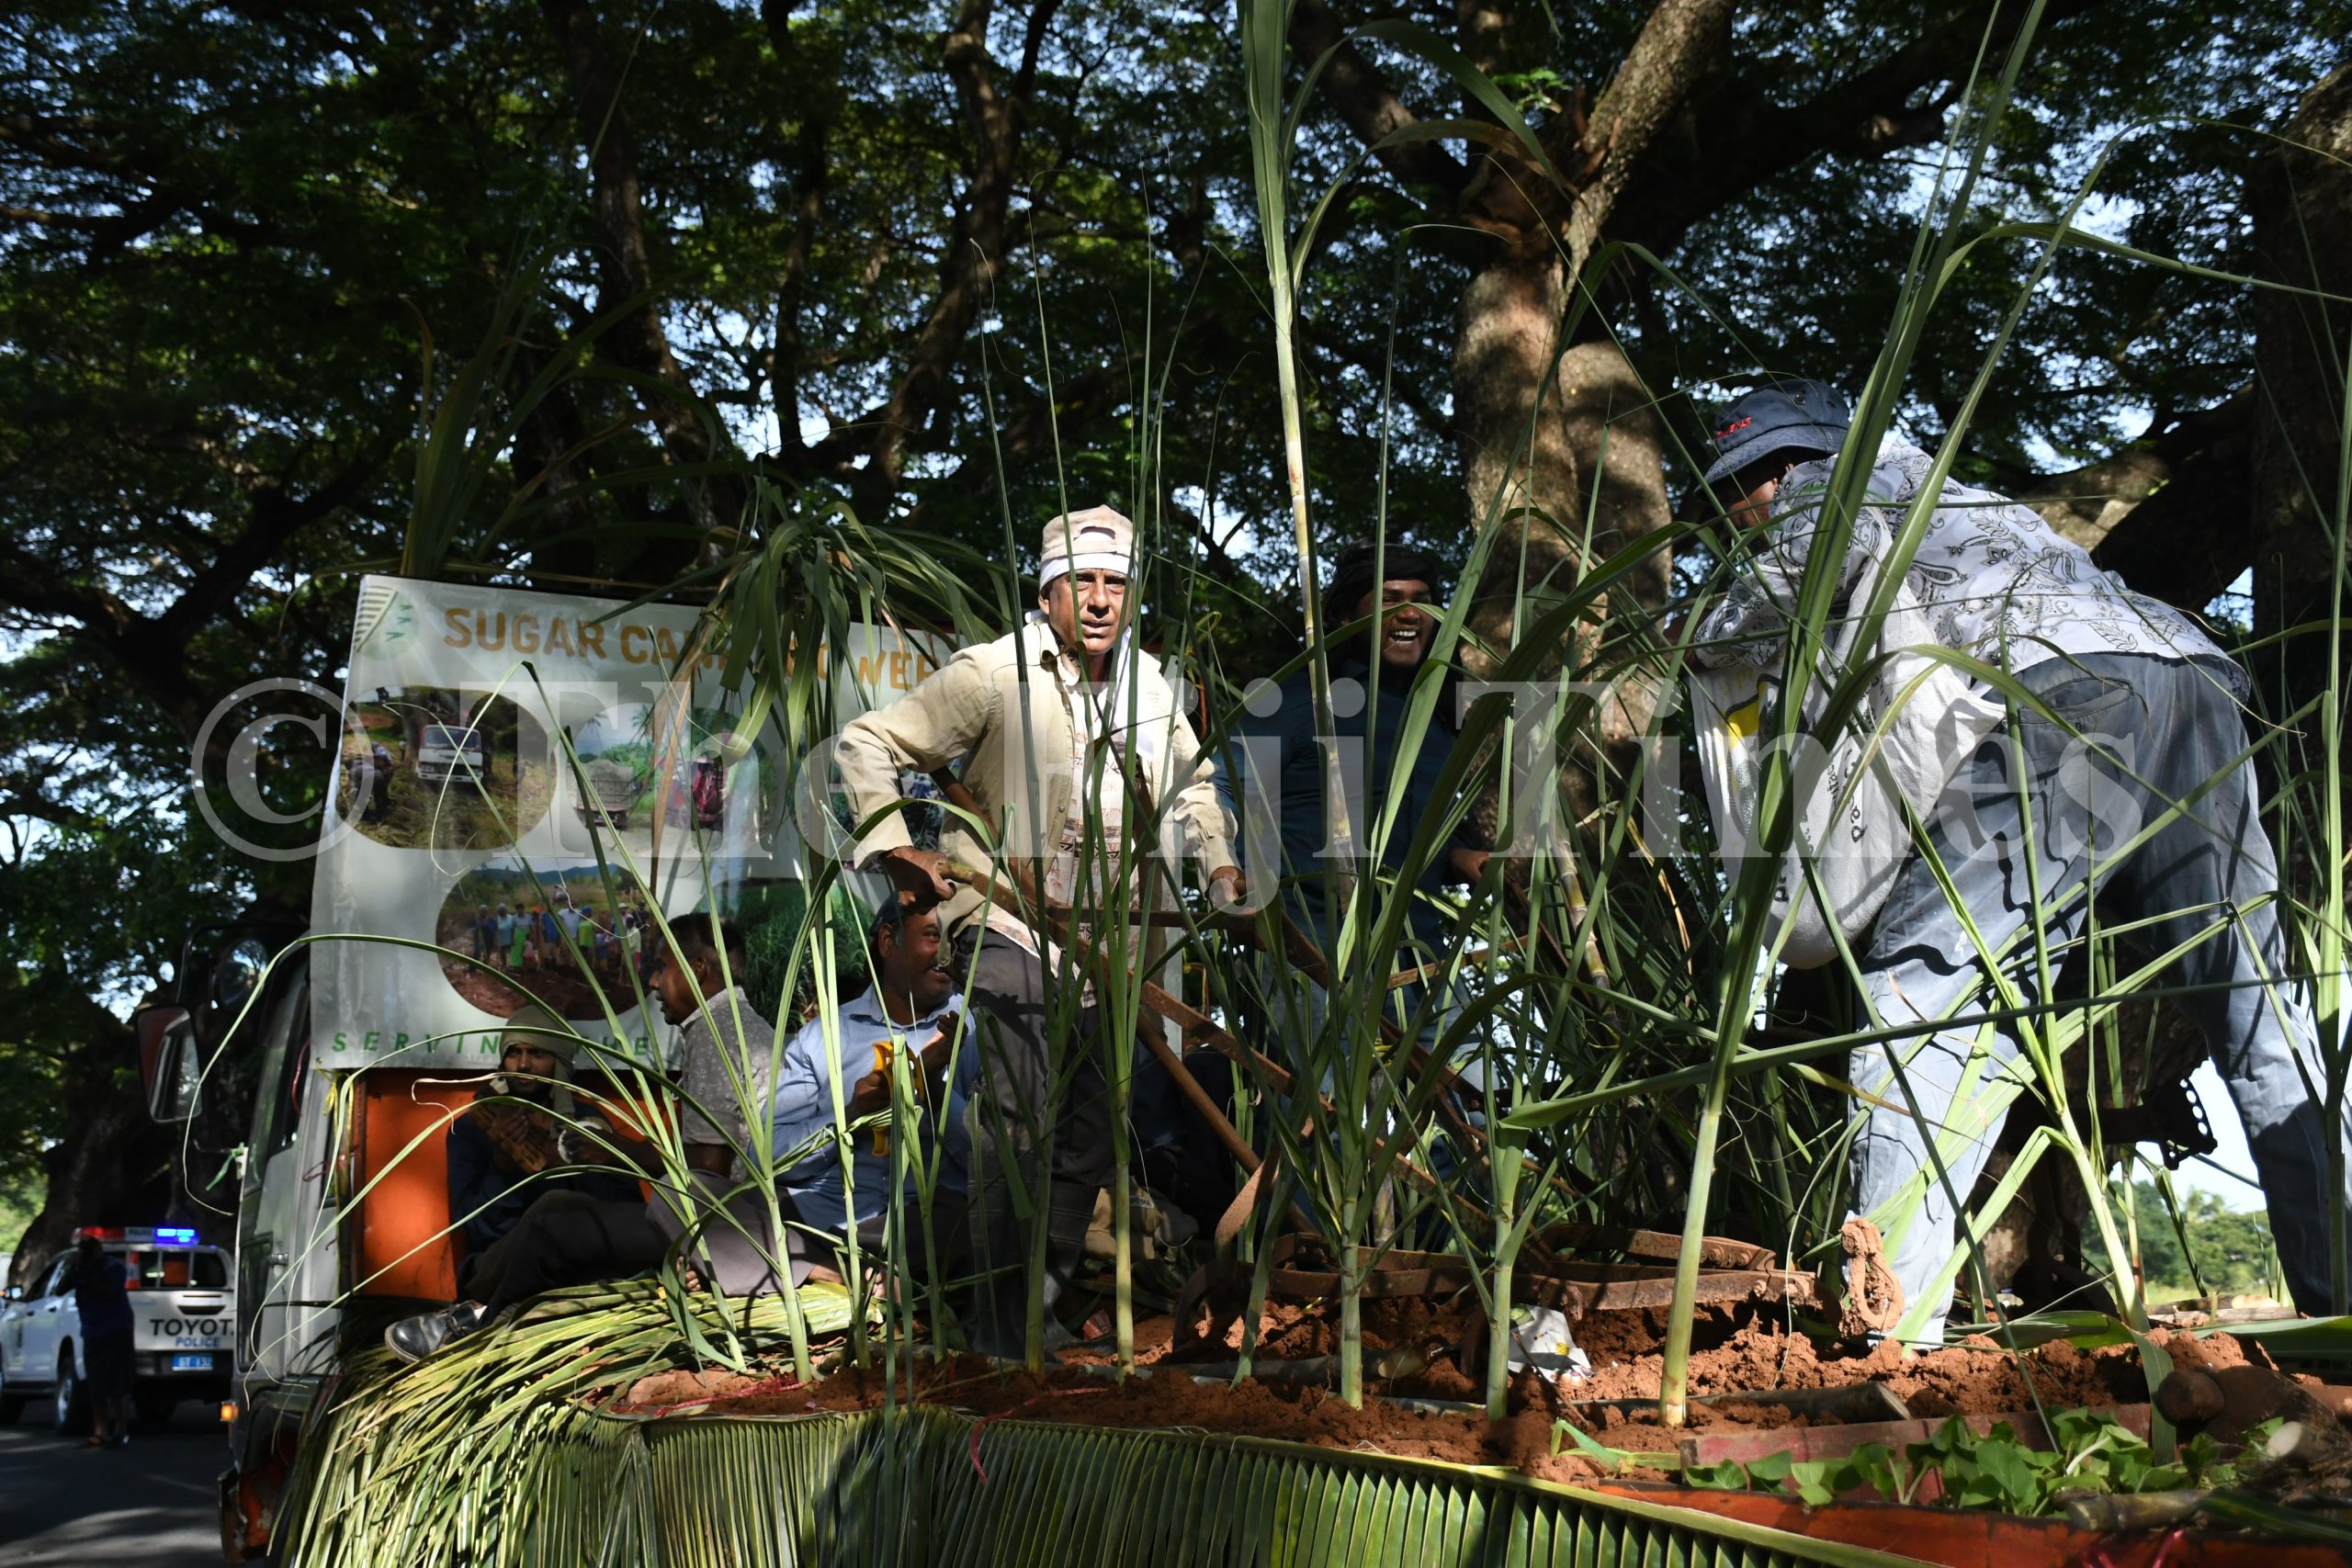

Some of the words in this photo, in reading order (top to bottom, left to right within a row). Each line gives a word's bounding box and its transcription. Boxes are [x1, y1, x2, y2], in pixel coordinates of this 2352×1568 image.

[444, 607, 606, 660] SUGAR
[332, 1032, 500, 1055] SERVIN
[150, 1318, 234, 1337] TOYOT
[175, 1337, 220, 1348] POLICE
